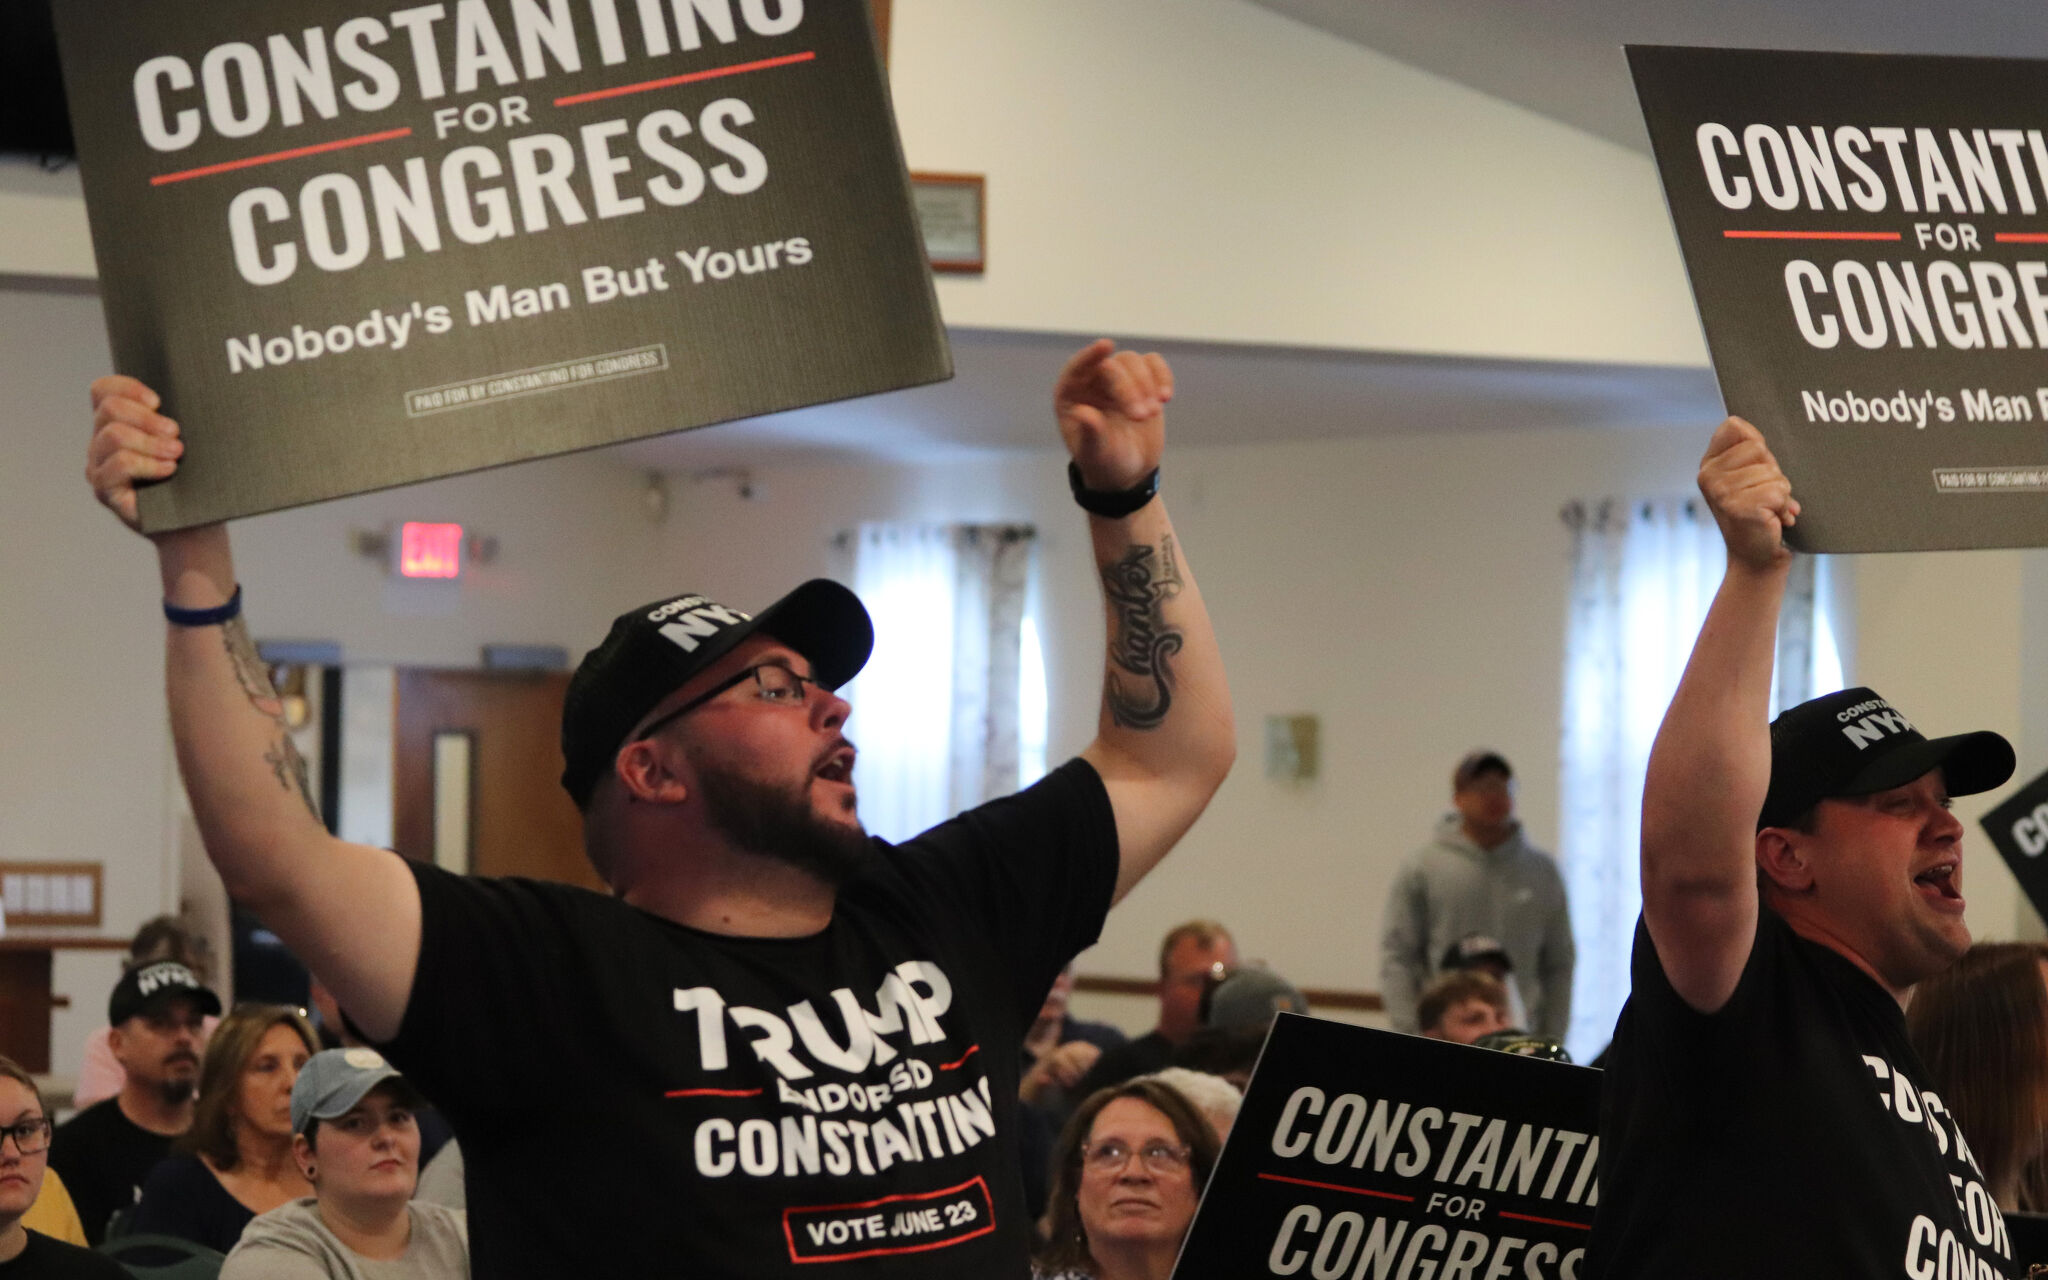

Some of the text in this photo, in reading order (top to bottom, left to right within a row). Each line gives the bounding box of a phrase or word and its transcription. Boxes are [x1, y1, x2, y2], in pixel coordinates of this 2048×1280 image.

[433, 95, 532, 140] FOR
[228, 97, 769, 286] CONGRESS
[1914, 223, 1982, 251] FOR
[225, 236, 813, 374] Nobody's Man But Yours
[1801, 389, 1955, 429] Nobody's
[1960, 388, 2033, 422] Man
[673, 960, 952, 1081] TRUMP
[806, 1200, 978, 1246] VOTE JUNE 23
[1426, 1192, 1485, 1221] FOR
